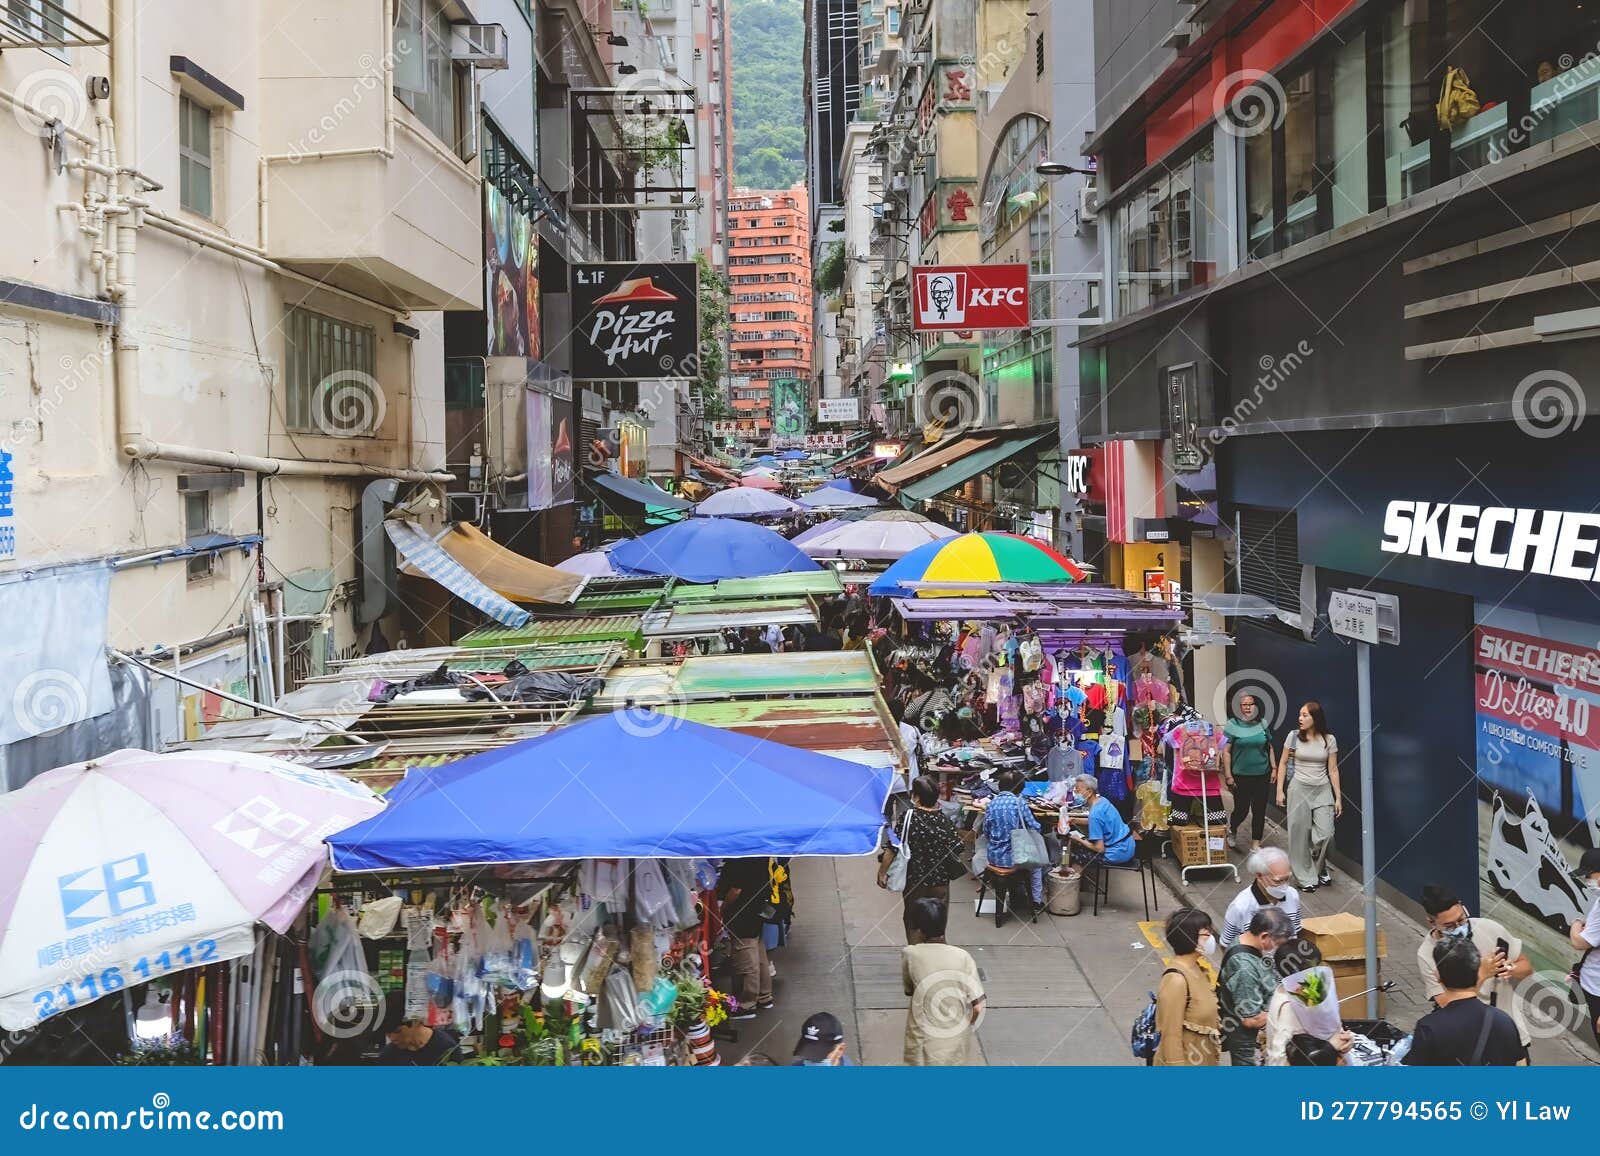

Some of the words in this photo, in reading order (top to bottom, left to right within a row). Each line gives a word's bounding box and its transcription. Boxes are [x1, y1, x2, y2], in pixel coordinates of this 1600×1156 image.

[591, 271, 605, 284] 1F
[968, 287, 1024, 307] KFC
[590, 305, 676, 346] Pizza
[604, 329, 673, 366] Hut
[1067, 455, 1087, 493] KFC
[1381, 499, 1600, 582] SKECHE
[1358, 601, 1374, 615] Street
[1554, 694, 1590, 737] 4.0
[1526, 736, 1563, 759] COMFORT
[33, 966, 124, 1020] 2116
[132, 938, 220, 978] 1112
